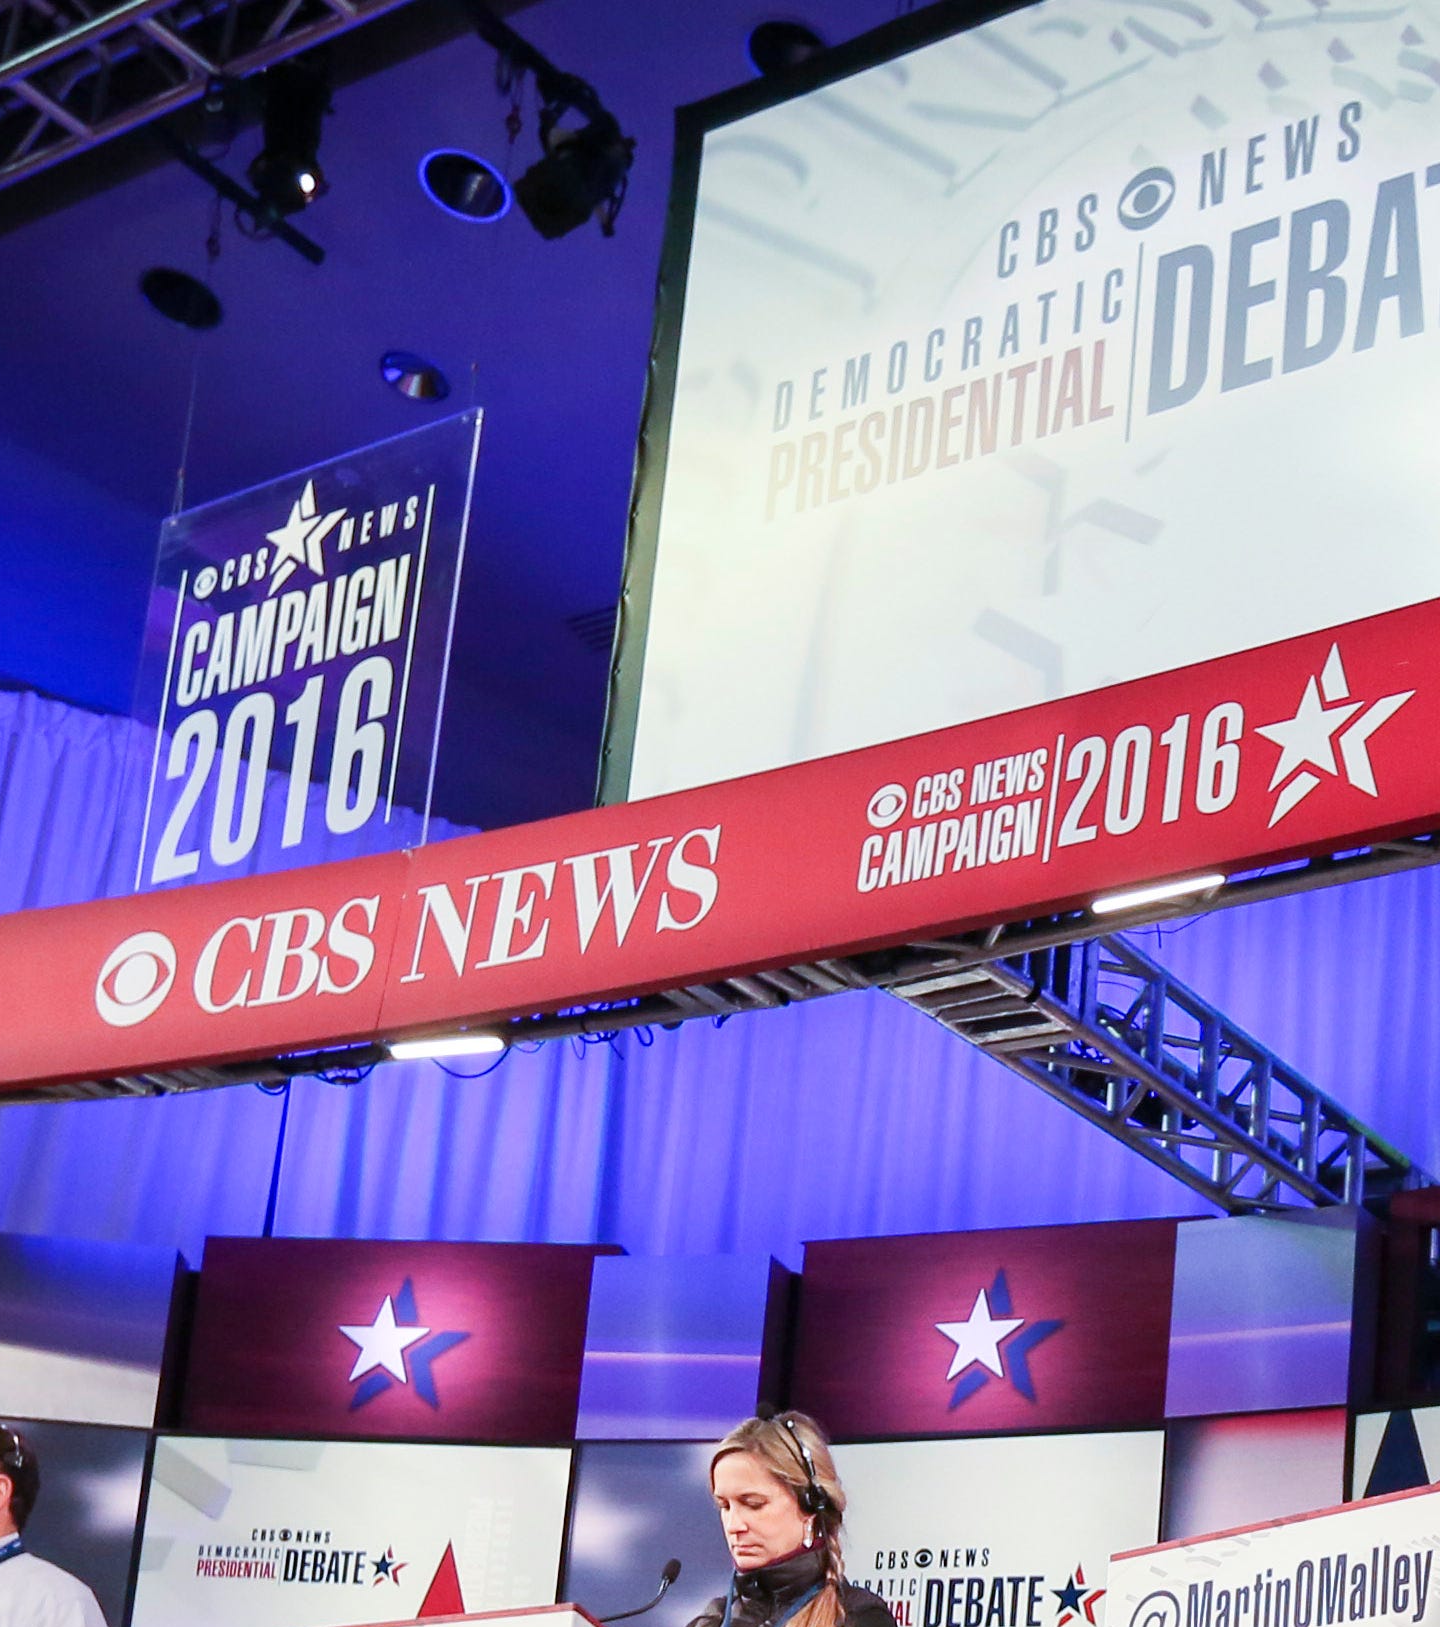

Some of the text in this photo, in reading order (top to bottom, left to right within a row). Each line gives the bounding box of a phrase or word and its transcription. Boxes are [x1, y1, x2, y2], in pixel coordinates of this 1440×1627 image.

[997, 100, 1362, 280] CBS NEWS
[772, 267, 1126, 435] DEMOCRATIC
[763, 338, 1116, 525] PRESIDENTIAL
[221, 495, 419, 593] CBS NEWS
[176, 552, 412, 708] CAMPAIGN
[151, 655, 395, 884] 2016
[913, 748, 1049, 817] CBS NEWS
[1057, 701, 1245, 847] 2016
[857, 798, 1044, 893] CAMPAIGN
[194, 824, 723, 1015] CBS NEWS
[196, 1560, 277, 1580] PRESIDENTIAL
[198, 1544, 280, 1560] DEMOCRATIC
[252, 1528, 331, 1544] CBS NEWS
[283, 1549, 367, 1585] DEBATE
[875, 1548, 990, 1570] CBS NEWS
